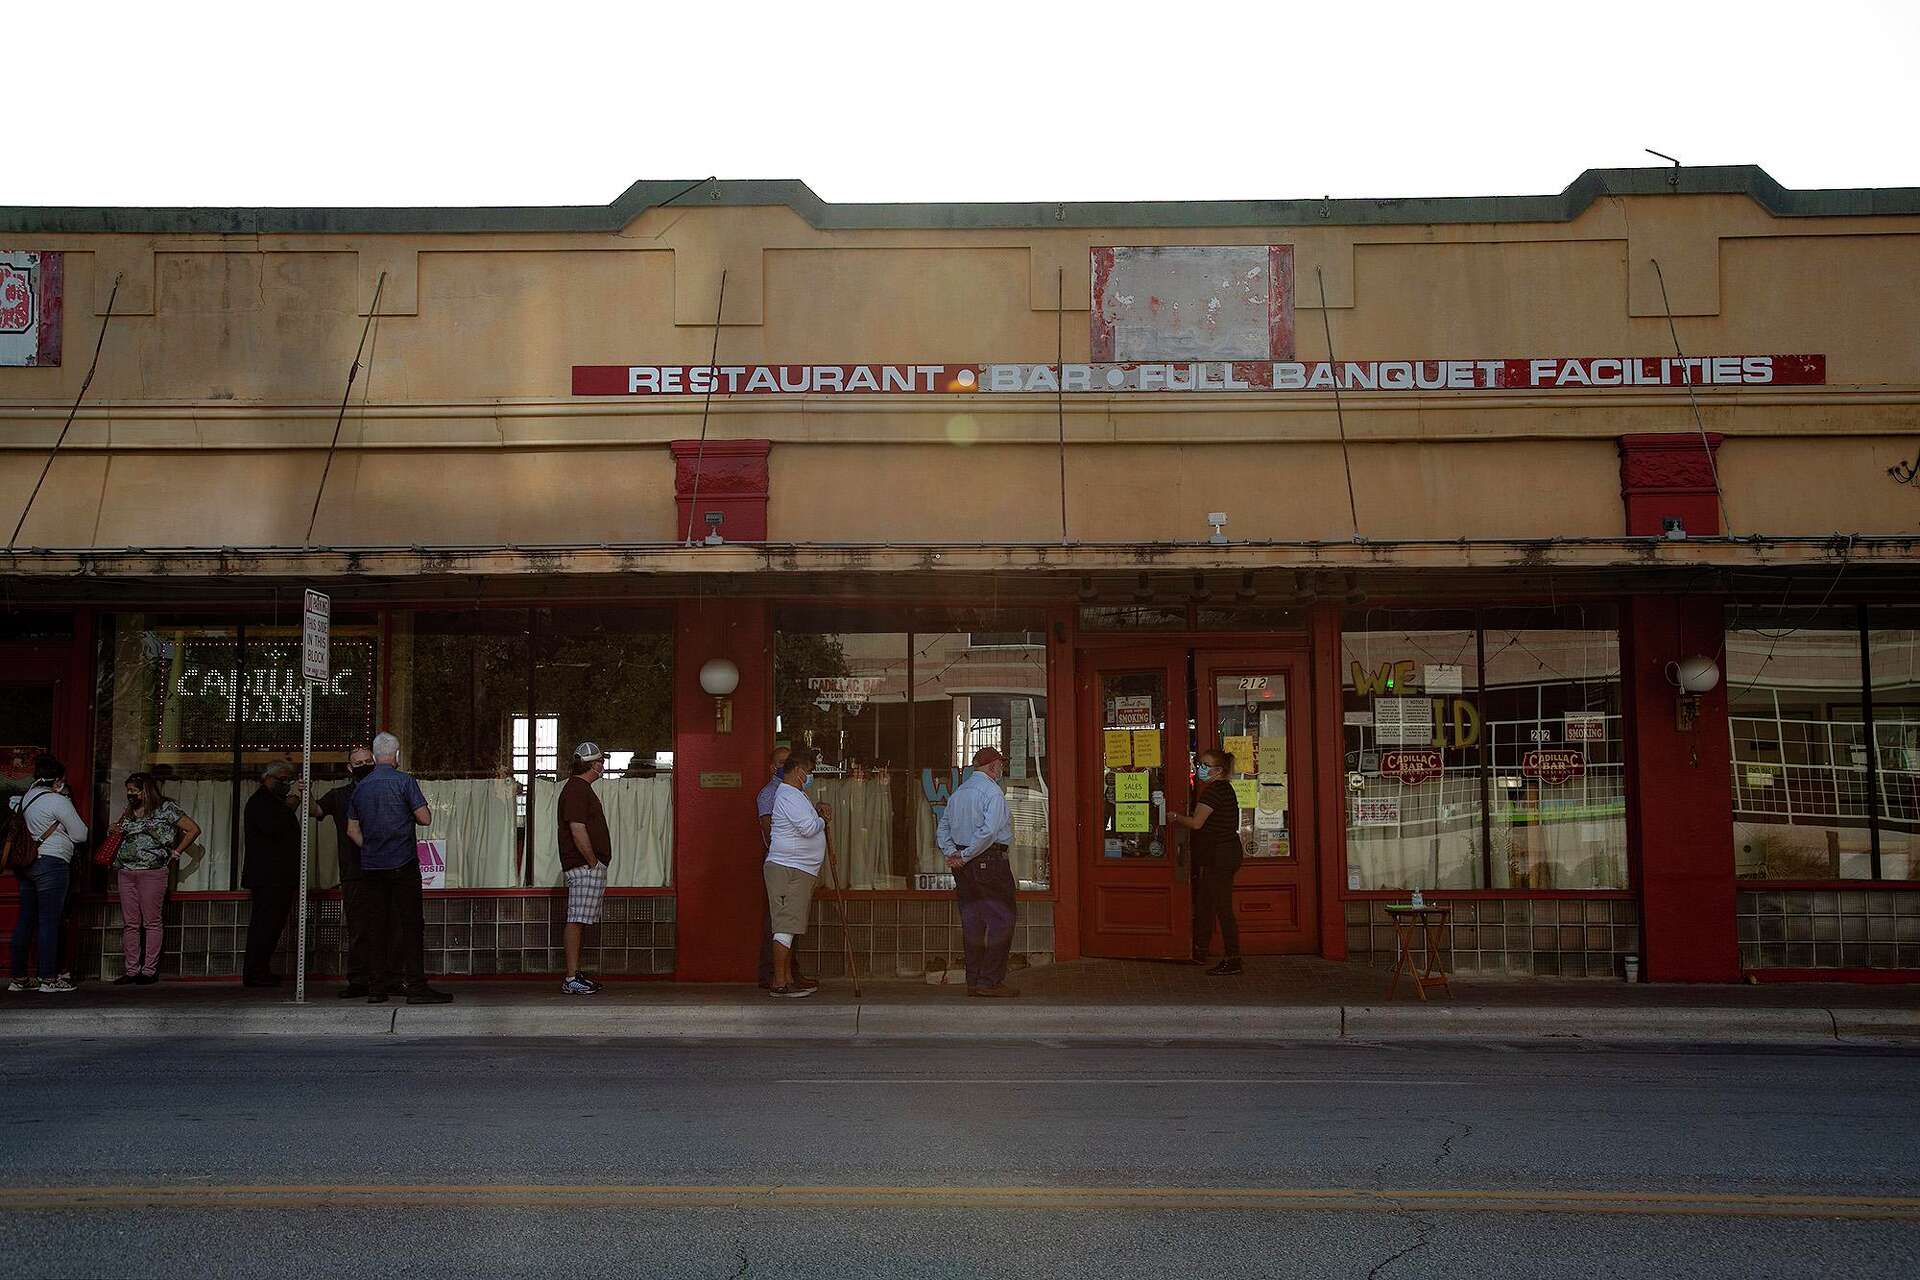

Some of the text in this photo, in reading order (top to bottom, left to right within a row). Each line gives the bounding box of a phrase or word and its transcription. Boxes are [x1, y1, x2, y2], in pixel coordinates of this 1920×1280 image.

[628, 356, 1774, 393] RESTAURANT BAR FULL BANQUET FACILITIES
[307, 617, 328, 634] THIS SIDE
[307, 633, 326, 649] IN THIS
[307, 649, 325, 664] BLOCK
[1241, 679, 1267, 689] 212
[1351, 660, 1419, 696] WE
[1118, 713, 1149, 723] SMOKING
[1432, 698, 1479, 748] ID
[1531, 730, 1550, 741] 212
[1568, 728, 1602, 738] SMOKING
[1388, 755, 1437, 769] CADILLAC
[1401, 762, 1424, 770] BAR
[1529, 754, 1579, 768] CADILLAC
[1542, 762, 1566, 770] BAR
[918, 875, 953, 889] OPEN
